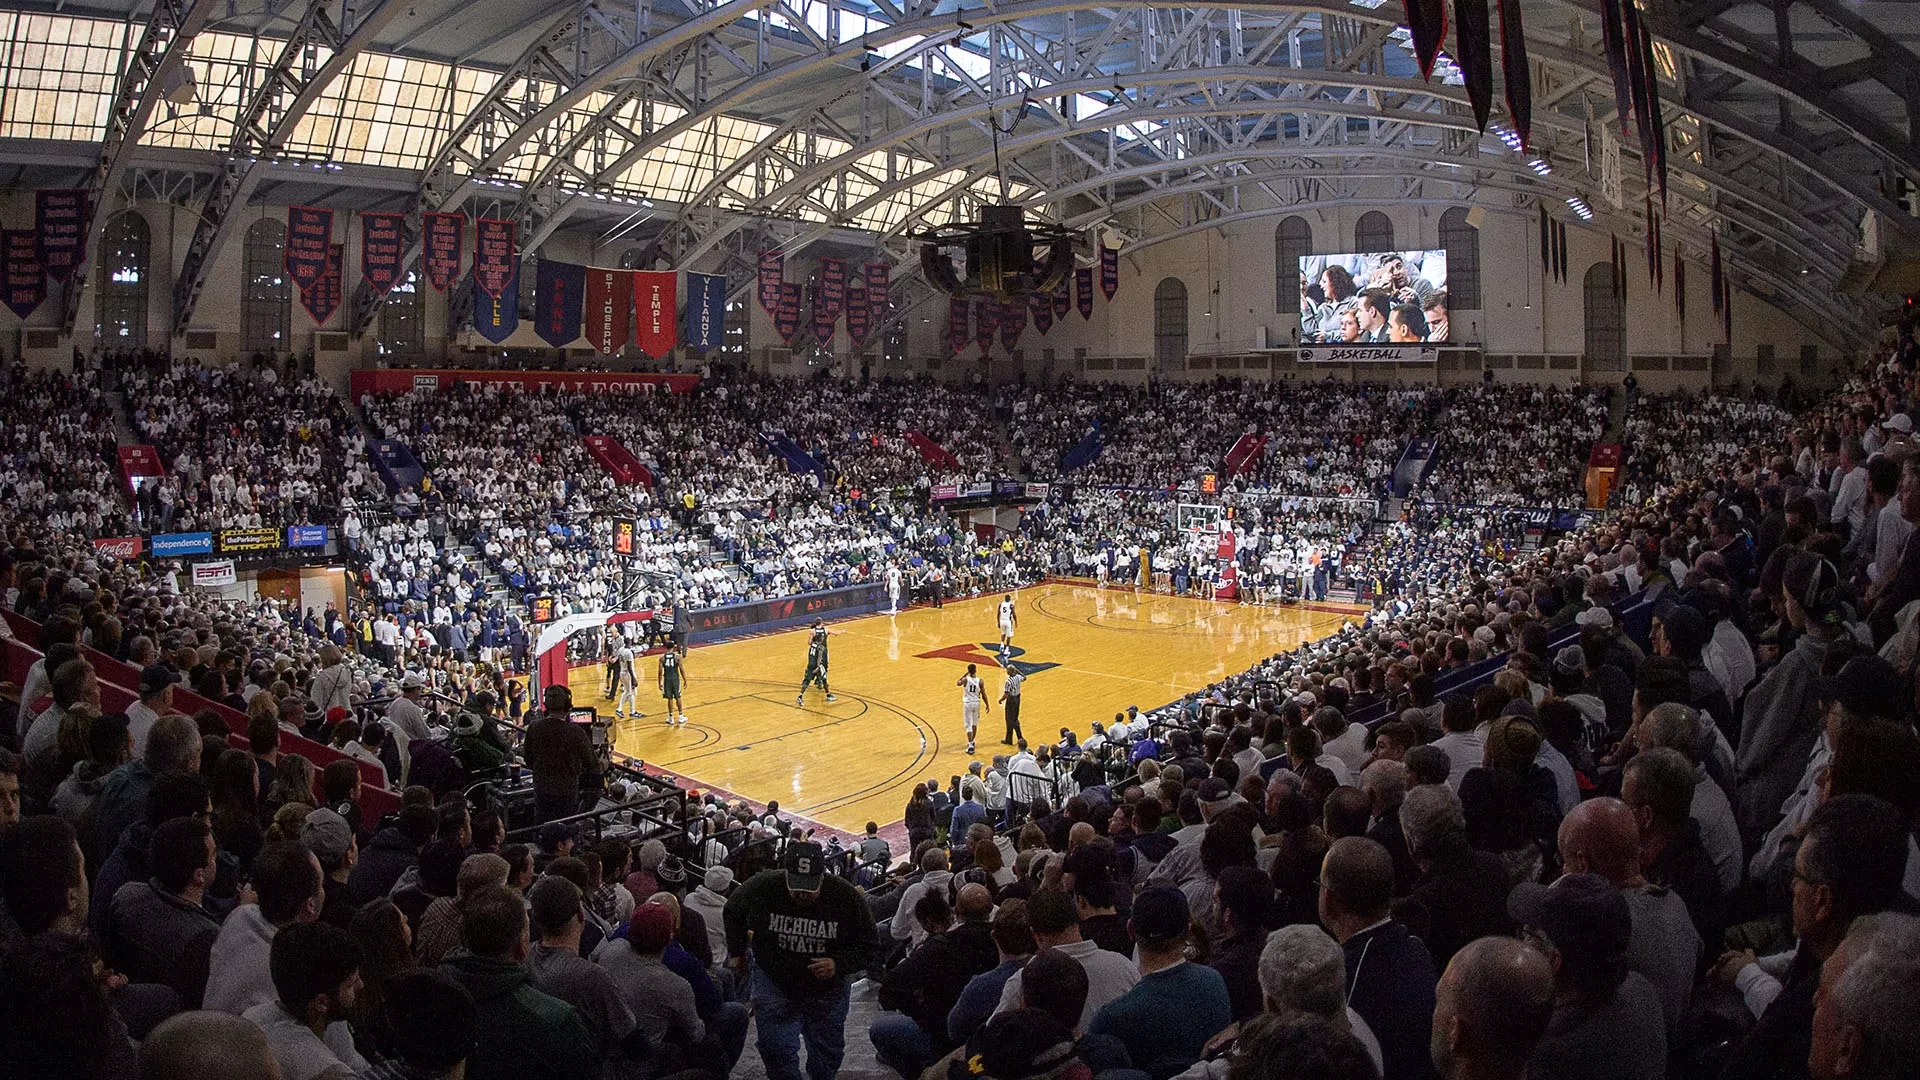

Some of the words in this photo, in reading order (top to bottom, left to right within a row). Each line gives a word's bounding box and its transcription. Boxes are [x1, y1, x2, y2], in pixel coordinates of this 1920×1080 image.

[552, 280, 564, 334] PENN
[651, 285, 661, 333] TEMPLE
[701, 277, 711, 346] VILLANOVA
[1327, 349, 1402, 360] BASKETBALL
[416, 377, 436, 385] PENN
[153, 539, 202, 550] Independence
[227, 535, 274, 544] theParkingSpot
[196, 564, 233, 578] ESPN
[815, 597, 843, 608] DELTA
[713, 612, 747, 625] DELTA
[798, 857, 811, 873] S
[768, 912, 839, 939] MICHIGAN
[778, 933, 827, 953] STATE
